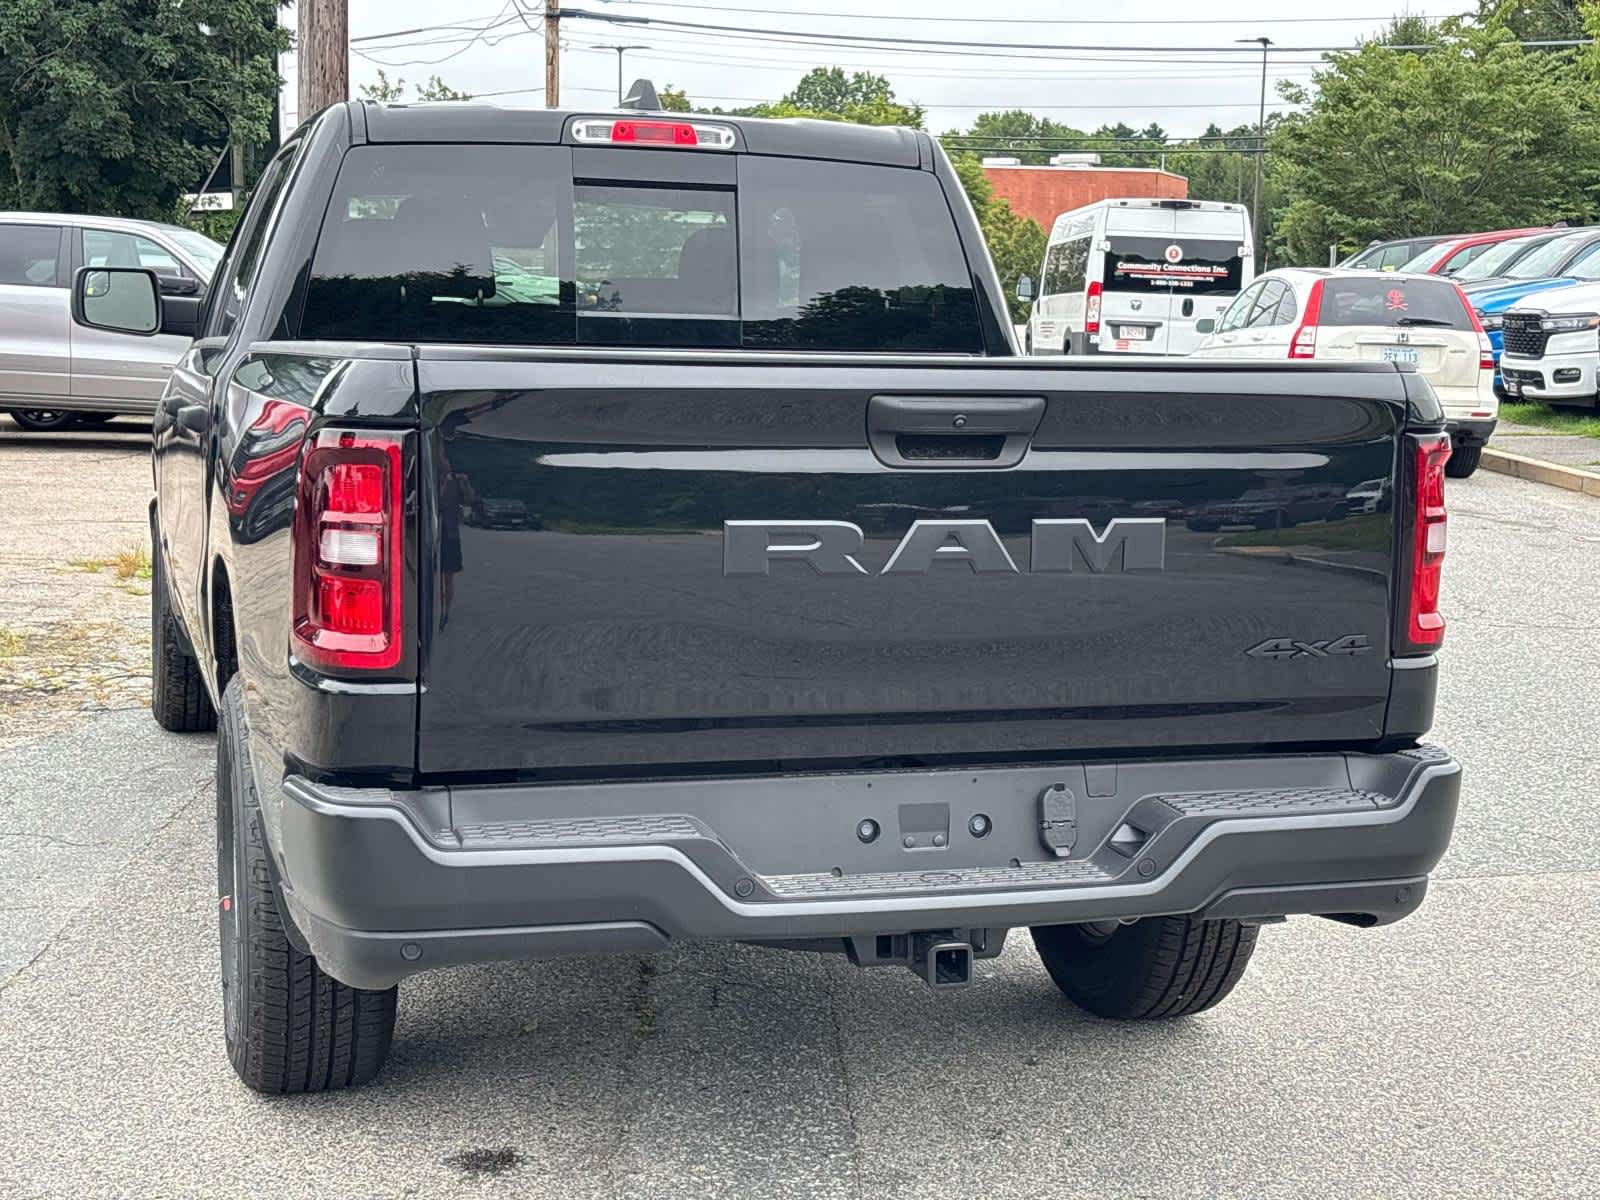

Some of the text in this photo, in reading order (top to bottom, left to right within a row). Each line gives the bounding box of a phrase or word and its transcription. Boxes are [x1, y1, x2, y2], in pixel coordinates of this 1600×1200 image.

[1117, 261, 1228, 273] Community Connections Inc.
[723, 518, 1167, 576] RAM
[1243, 633, 1374, 660] 4x4
